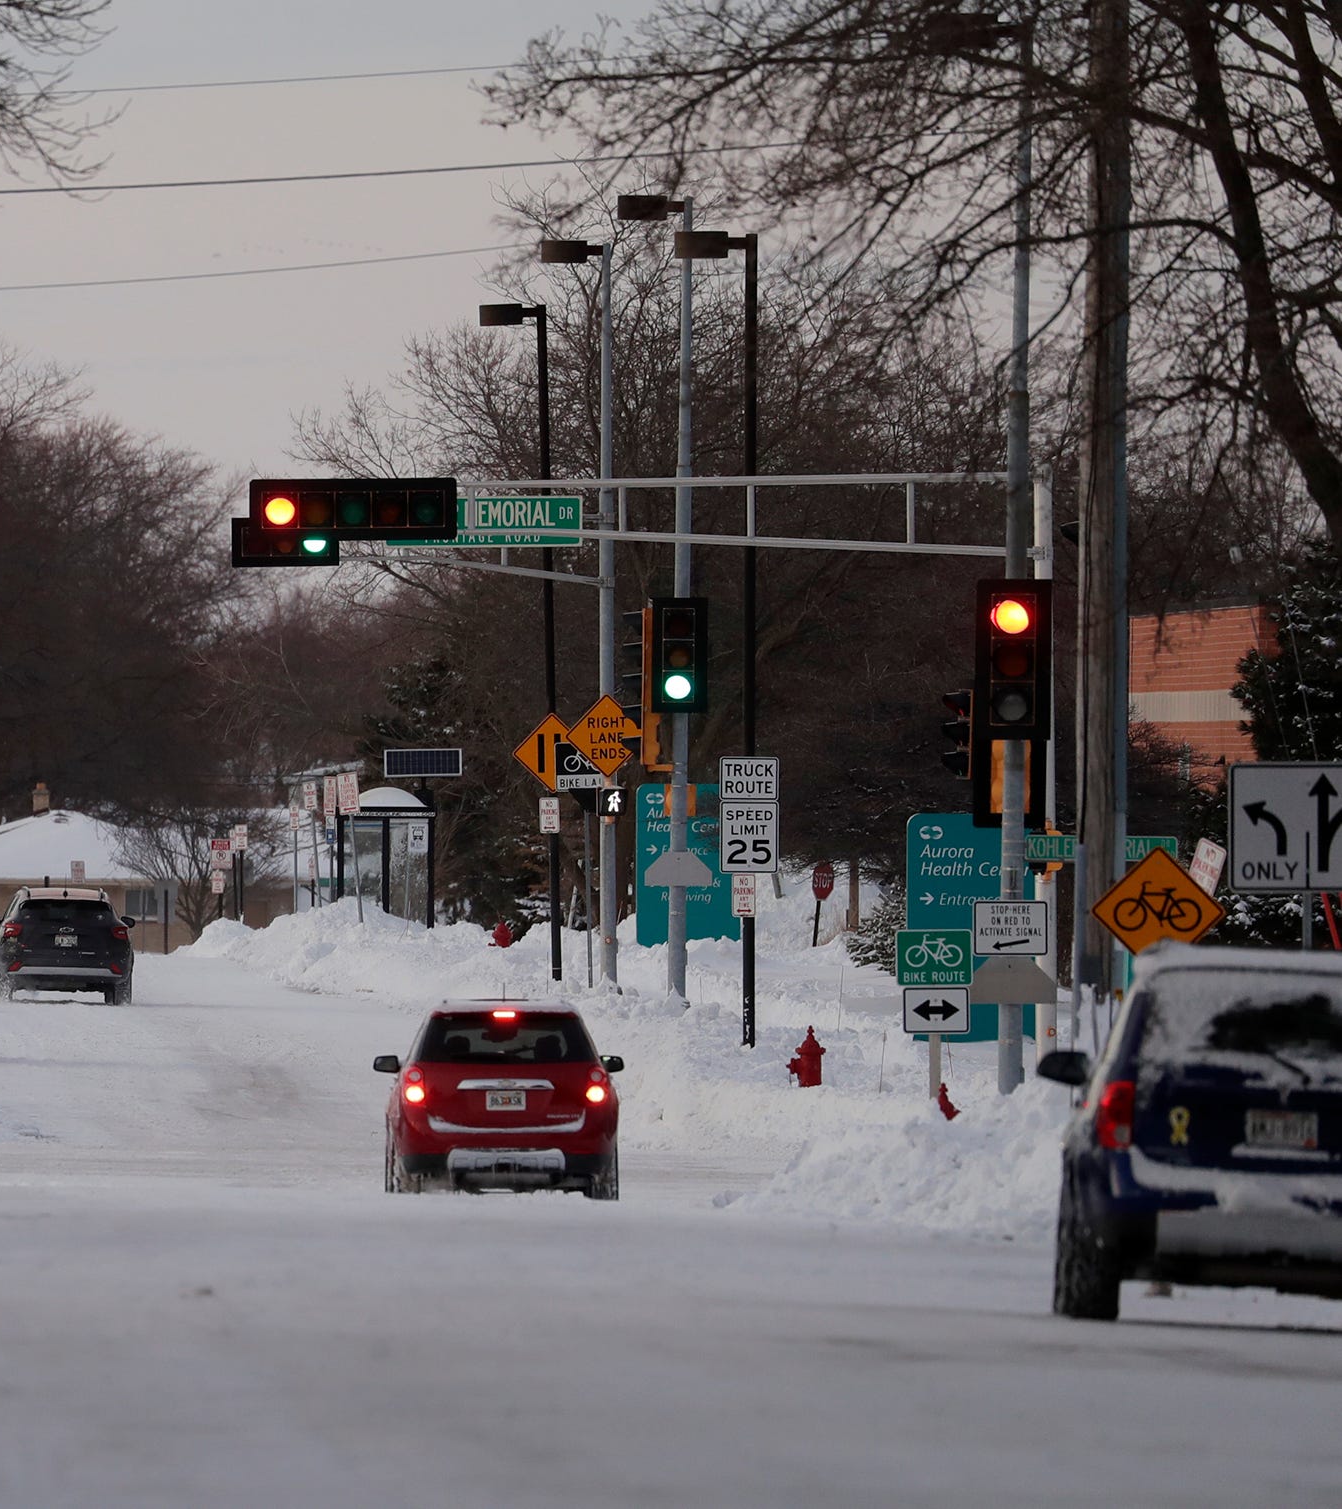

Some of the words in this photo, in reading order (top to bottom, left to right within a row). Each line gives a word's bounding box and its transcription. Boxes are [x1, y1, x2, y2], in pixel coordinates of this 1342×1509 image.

[559, 506, 573, 520] DR
[587, 717, 626, 729] RIGHT
[589, 732, 625, 744] LANE
[591, 748, 626, 760] ENDS
[724, 763, 774, 777] TRUCK
[559, 779, 580, 788] BIKE
[584, 778, 601, 787] LA
[724, 781, 773, 794] ROUTE
[726, 810, 773, 821] SPEED
[731, 825, 767, 836] LIMIT
[726, 839, 772, 865] 25
[920, 844, 974, 859] Aurora
[1028, 838, 1076, 857] KOHLE
[1205, 847, 1217, 863] NO
[920, 862, 973, 876] Health
[1242, 861, 1298, 881] ONLY
[712, 877, 721, 888] &
[739, 877, 749, 886] NO
[812, 871, 833, 888] STOP
[733, 887, 755, 895] PARKING
[991, 905, 1009, 914] STOP
[1012, 905, 1031, 914] HERE
[991, 916, 1001, 925] ON
[1004, 916, 1018, 925] RED
[1022, 916, 1031, 925] TO
[979, 928, 1012, 936] ACTIVATE
[1016, 928, 1042, 936] SIGNAL
[903, 971, 927, 983] BIKE
[932, 971, 965, 982] ROUTE
